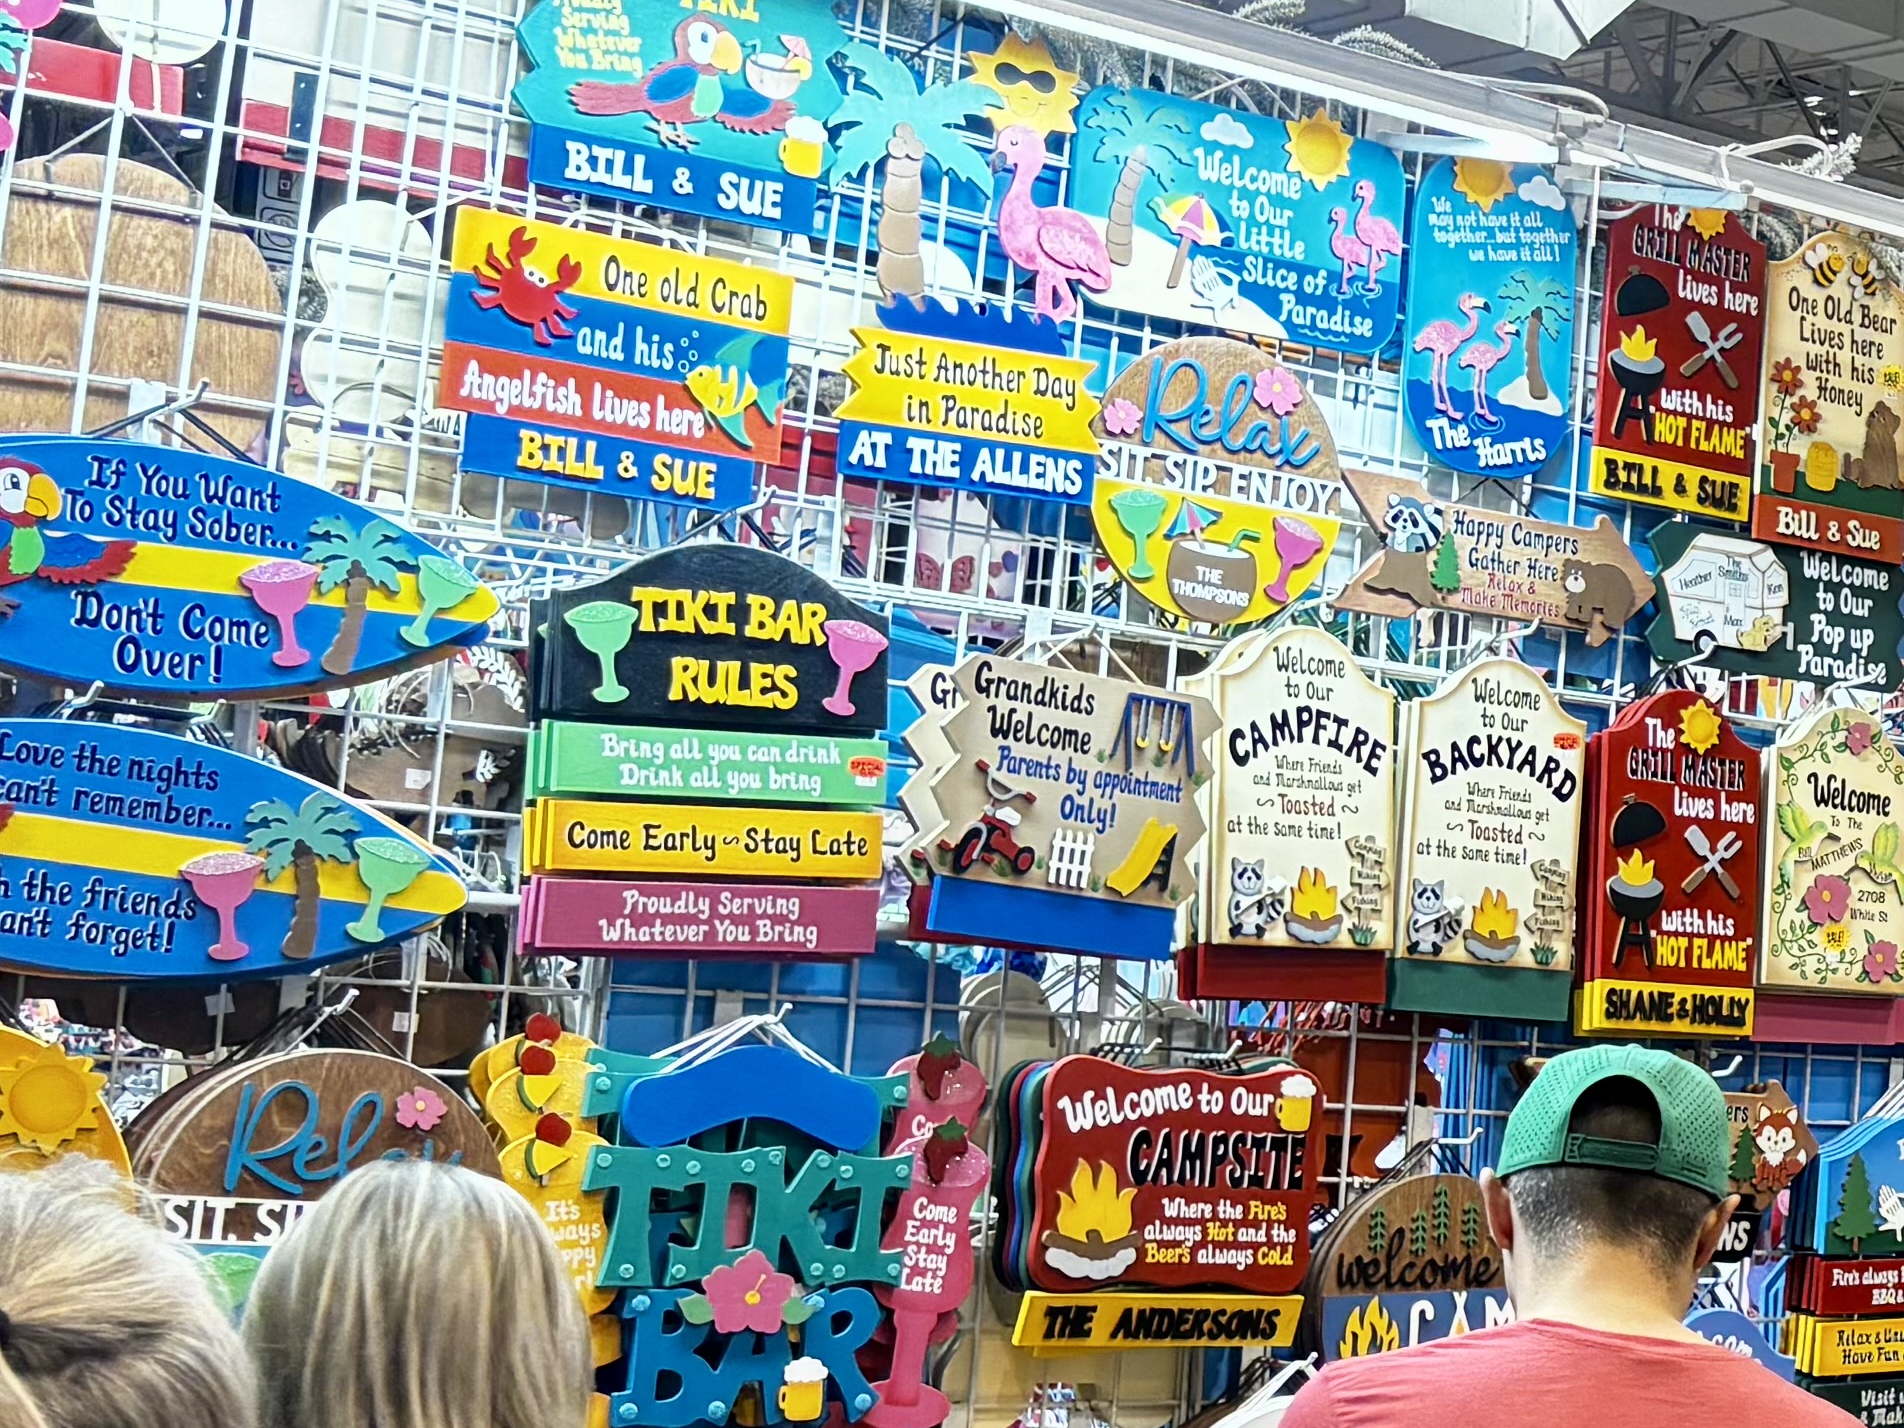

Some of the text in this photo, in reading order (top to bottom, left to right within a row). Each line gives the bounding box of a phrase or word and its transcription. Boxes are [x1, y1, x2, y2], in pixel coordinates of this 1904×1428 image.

[565, 142, 782, 217] BILL & SUE
[1196, 149, 1301, 200] Welcome
[1230, 198, 1293, 224] to Our
[604, 255, 768, 321] One old Crab
[1243, 257, 1327, 294] Slice of
[1280, 294, 1372, 338] Paradise
[577, 323, 674, 370] and his
[461, 362, 705, 438] Angelfish lives here
[875, 343, 1076, 411] Just Another Day
[905, 394, 1043, 438] in Paradise
[1144, 359, 1320, 468] Relax
[517, 430, 717, 499] BILL & SUE
[849, 432, 1082, 495] AT THE ALLENS
[1427, 418, 1547, 465] The Harris
[86, 455, 281, 513] If You Want
[65, 488, 95, 522] To
[104, 496, 178, 542] Stay
[1452, 509, 1578, 556] Happy Campers
[1195, 565, 1223, 584] THE
[1469, 549, 1559, 582] Gather Here
[631, 586, 828, 646] TIKI BAR
[1172, 580, 1249, 606] THOMPSONS
[71, 589, 271, 647] Don't Come
[114, 635, 222, 683] Over!
[669, 656, 797, 709] RULES
[1275, 645, 1346, 679] Welcome
[975, 661, 1096, 716] Grandkids
[602, 733, 840, 765] Bring all you can drink
[987, 706, 1092, 757] Welcome
[1229, 705, 1387, 776] CAMPFIRE
[1646, 717, 1676, 749] The
[620, 764, 821, 797] Drink all you bring
[997, 745, 1182, 805] Parents by appointment
[1421, 735, 1576, 803] BACKYARD
[1628, 750, 1745, 790] GRILL MASTER
[1060, 795, 1117, 833] Only!
[1673, 789, 1754, 824] lives here
[1808, 772, 1890, 818] Welcome
[566, 822, 868, 861] Come Early Stay Late
[1810, 837, 1863, 871] MATTHEWS
[1857, 890, 1885, 905] 2708
[1605, 989, 1676, 1021] SHANE
[1692, 989, 1750, 1027] HOLLY
[1058, 1081, 1274, 1136] Welcome to Our
[1128, 1128, 1306, 1192] CAMPSITE
[581, 1146, 912, 1288] TIKI
[1162, 1197, 1288, 1221] Where the Fire's
[1144, 1219, 1296, 1247] always Hot and the
[1146, 1242, 1294, 1269] Beer's always Cold
[1336, 1227, 1499, 1288] welcome
[1042, 1306, 1280, 1342] THE ANDERSONS
[611, 1288, 881, 1427] BAR
